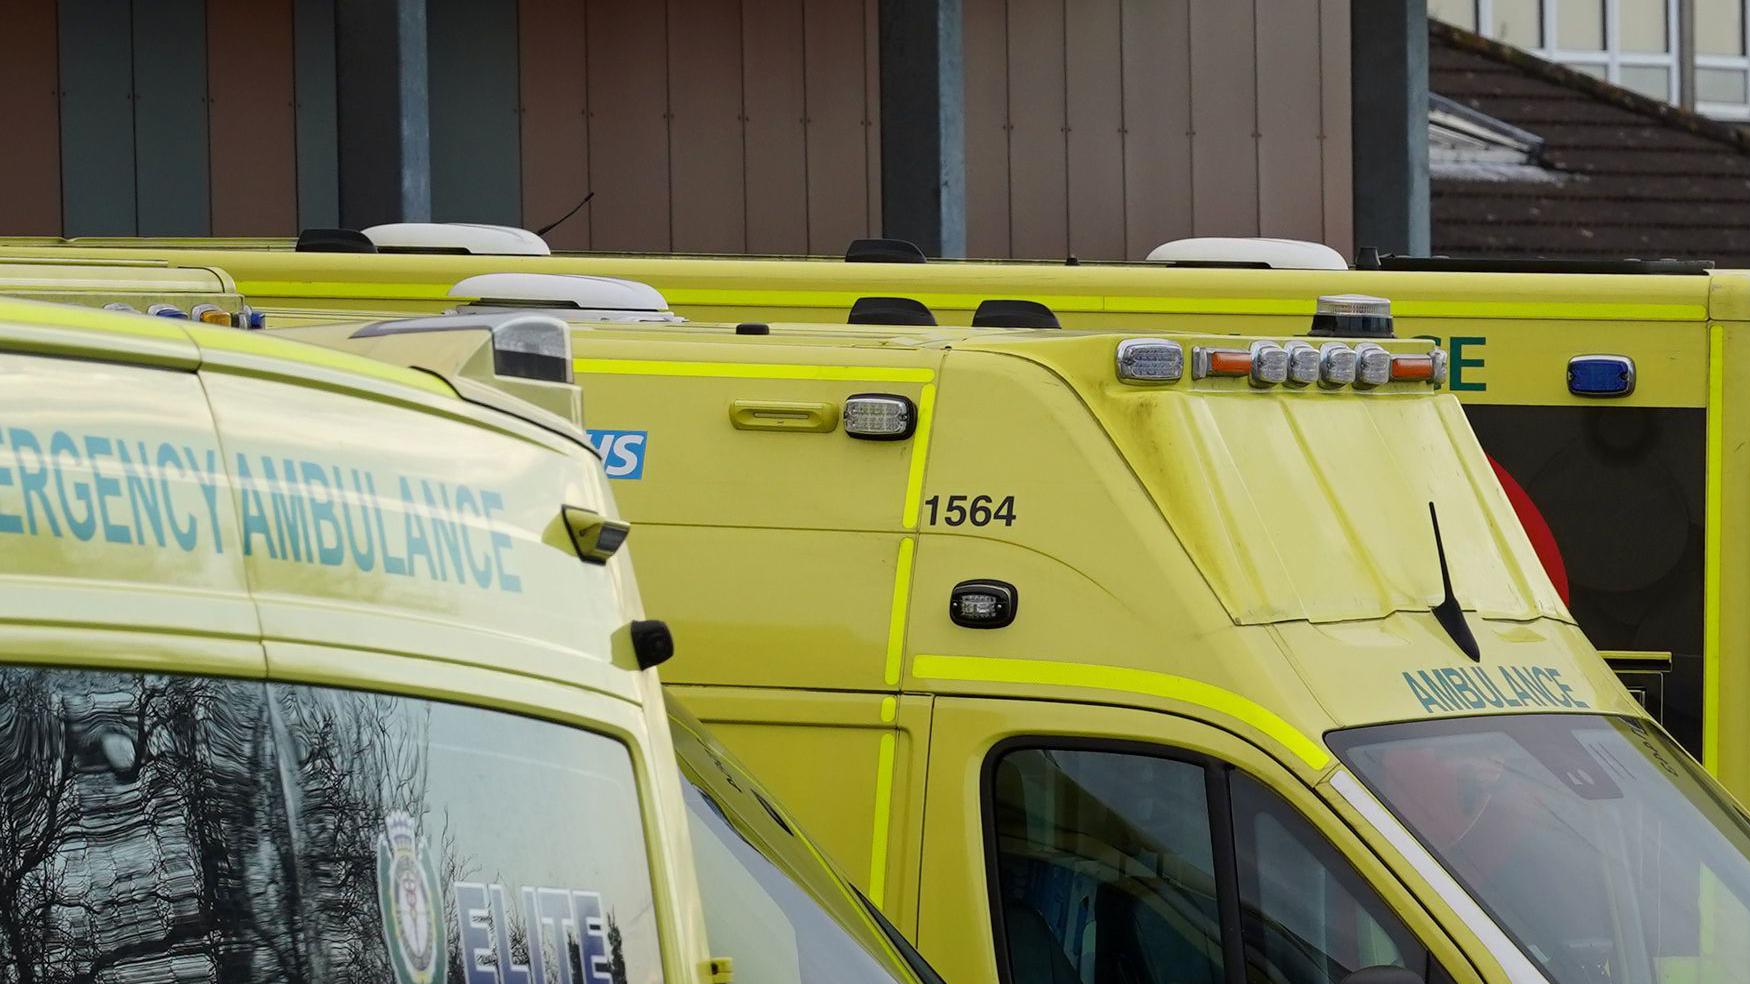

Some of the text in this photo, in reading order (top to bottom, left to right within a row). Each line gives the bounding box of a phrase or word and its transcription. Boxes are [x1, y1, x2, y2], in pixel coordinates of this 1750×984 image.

[585, 433, 645, 477] HS
[0, 426, 522, 593] ERGENCY AMBULANCE
[924, 494, 1018, 527] 1564
[1401, 665, 1591, 714] AMBULANCE
